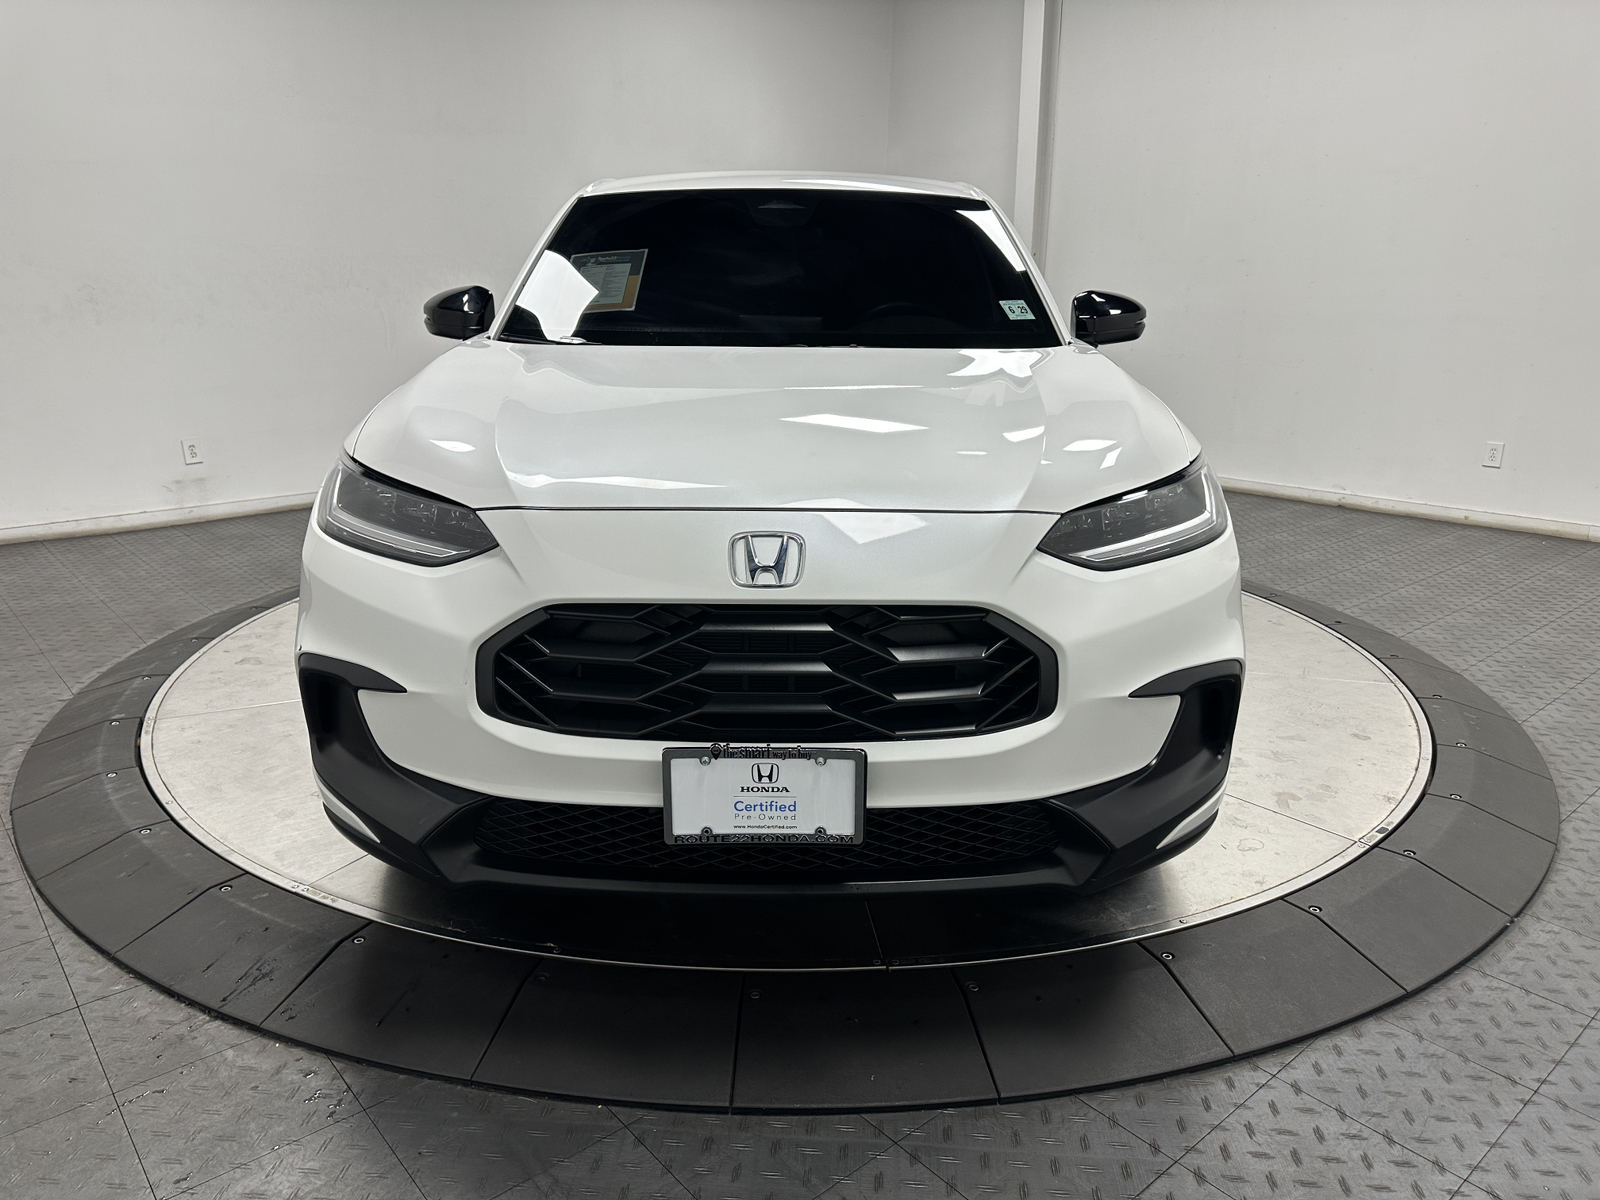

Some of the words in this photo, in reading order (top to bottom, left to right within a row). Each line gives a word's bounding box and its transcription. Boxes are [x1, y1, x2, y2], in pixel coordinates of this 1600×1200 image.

[1008, 306, 1015, 314] 6
[1017, 306, 1028, 314] 29
[723, 743, 738, 758] the
[740, 744, 770, 758] smart
[773, 751, 787, 760] way
[788, 748, 797, 759] to
[797, 745, 812, 760] buy
[733, 800, 797, 812] Certified
[734, 813, 796, 821] Pre-Owned
[674, 834, 854, 844] ROUTE22HONDA.COM
